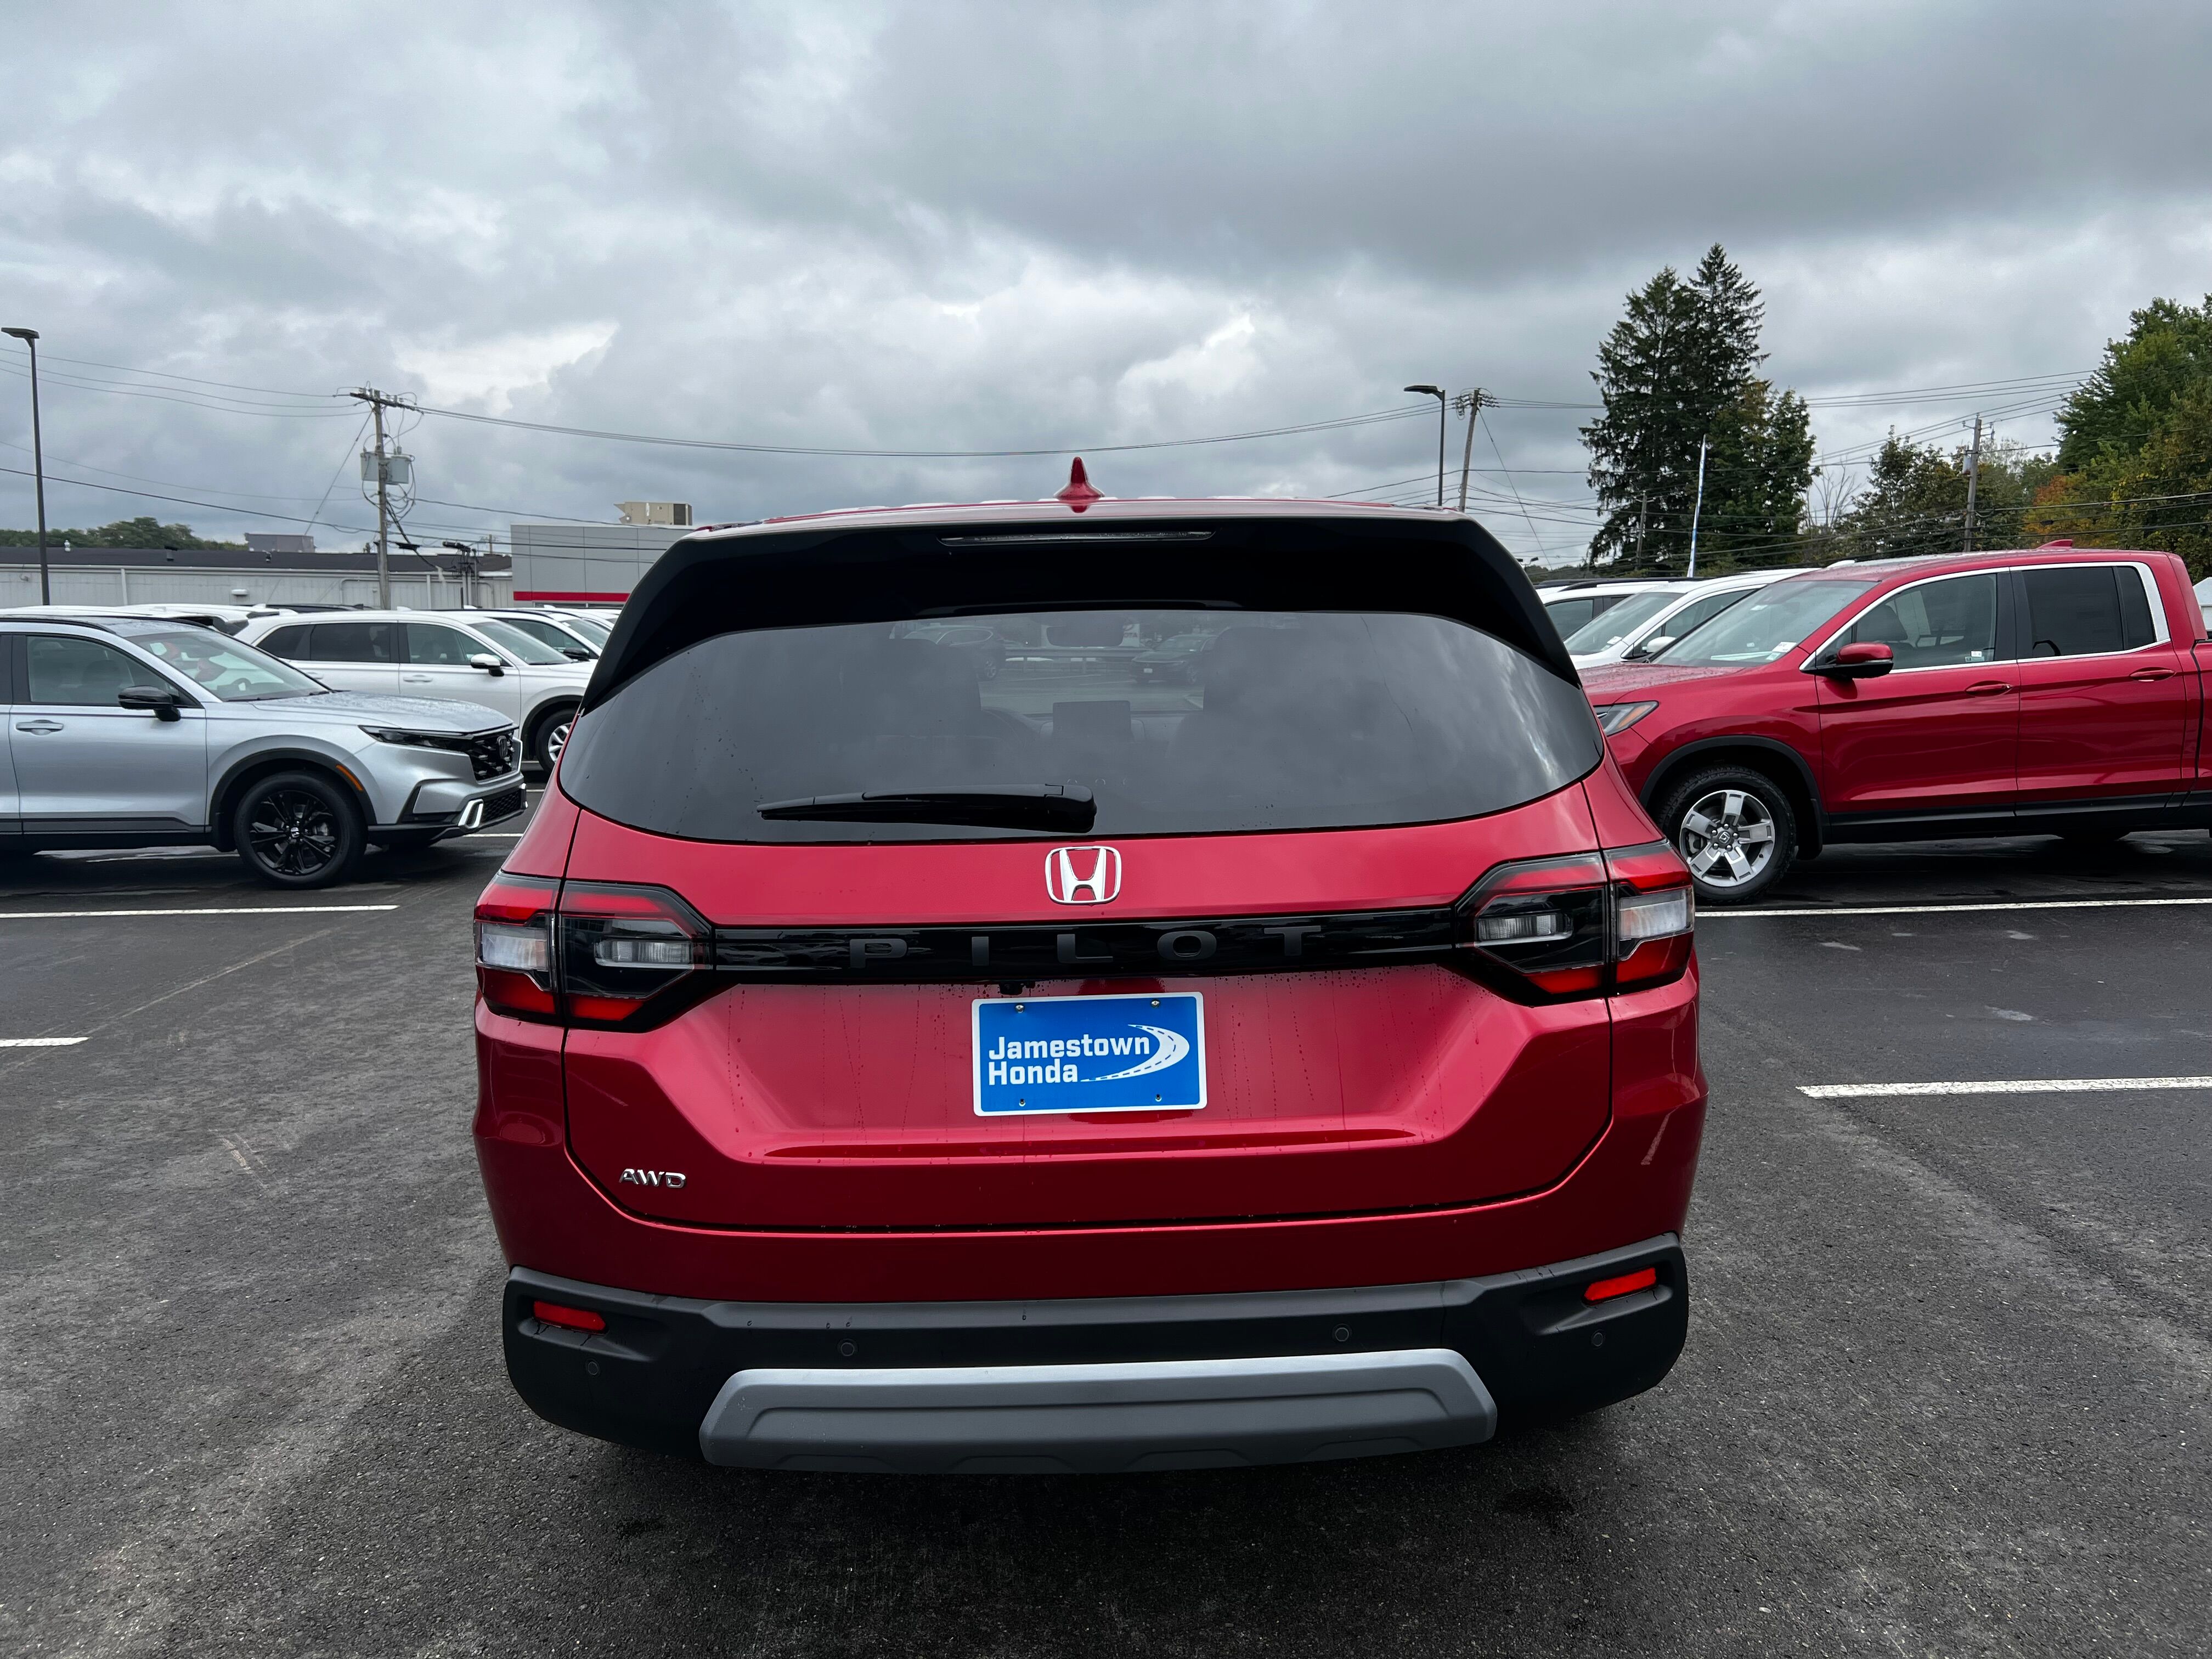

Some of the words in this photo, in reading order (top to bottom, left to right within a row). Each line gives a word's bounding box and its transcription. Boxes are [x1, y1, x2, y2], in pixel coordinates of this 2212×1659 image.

[849, 926, 1322, 969] PILOT
[989, 1034, 1150, 1059] Jamestown
[989, 1058, 1078, 1085] Honda
[619, 1169, 687, 1188] AWD
